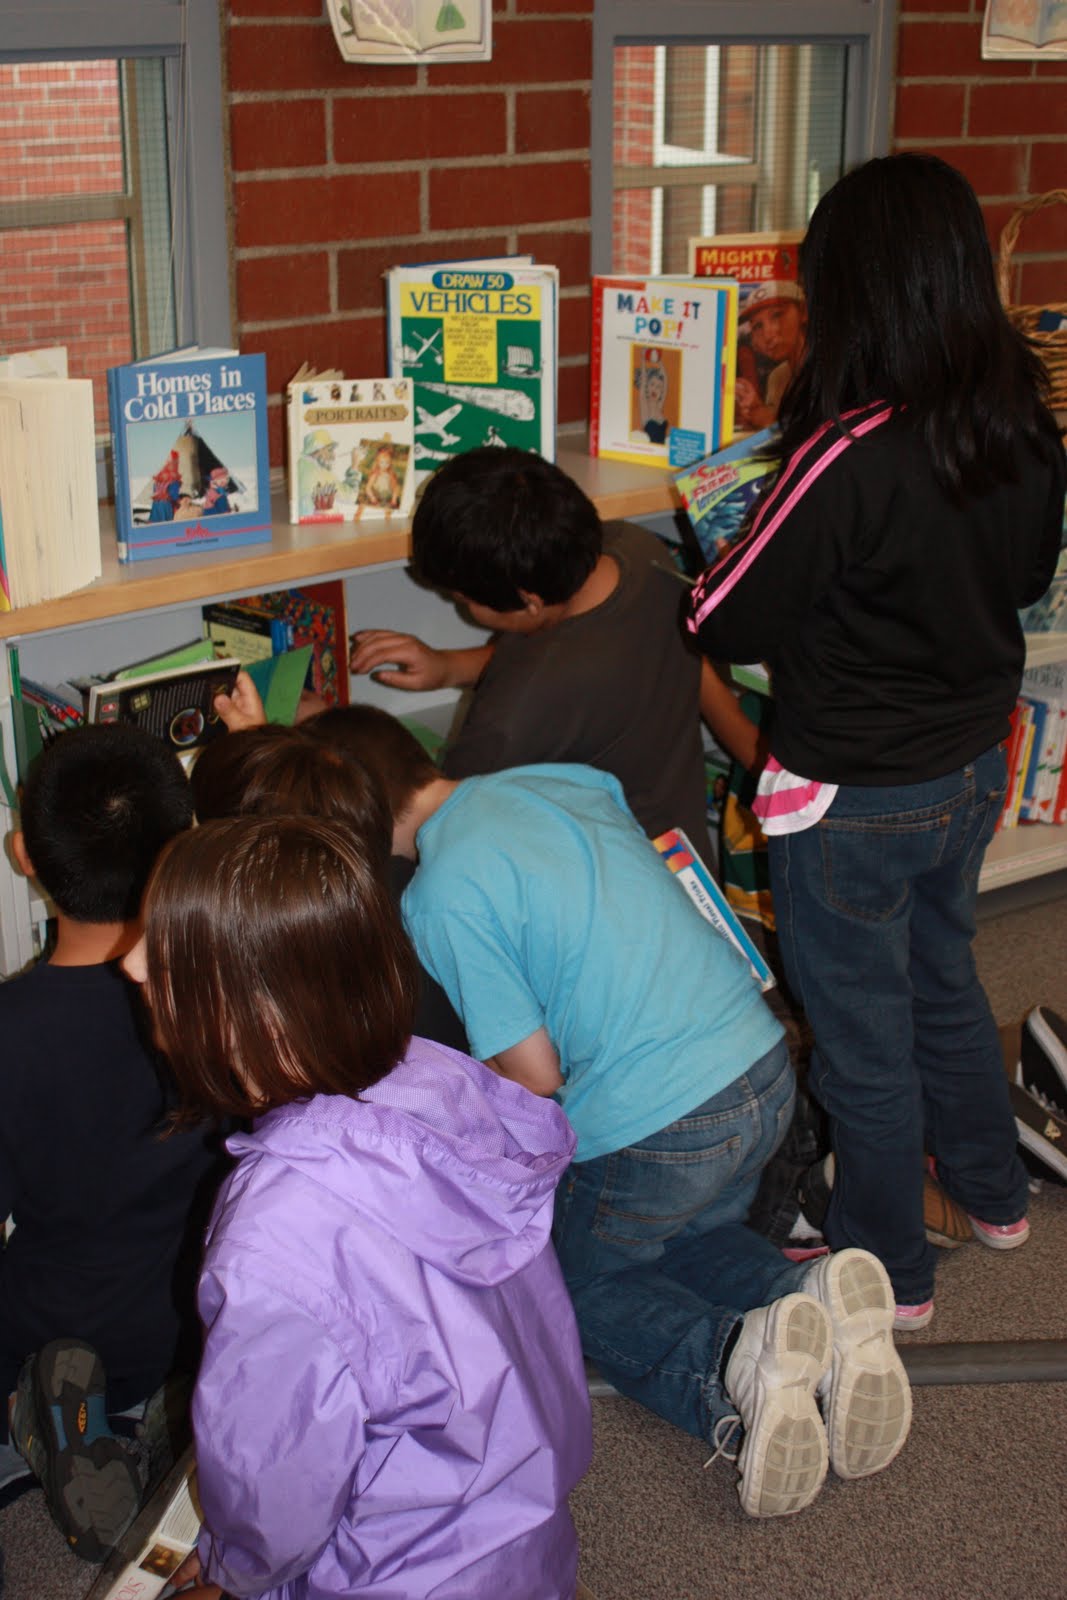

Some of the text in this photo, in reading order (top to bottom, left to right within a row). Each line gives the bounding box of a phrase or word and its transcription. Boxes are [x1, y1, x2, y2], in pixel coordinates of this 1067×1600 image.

[701, 248, 778, 266] MIGHTY
[441, 273, 485, 288] DRAW
[487, 274, 505, 289] 50
[705, 264, 774, 279] JACKIE
[410, 291, 532, 315] VEHICLES
[617, 293, 701, 320] MAKE IT
[635, 317, 684, 339] POP!
[136, 365, 242, 398] Homes in
[124, 391, 256, 423] Cold Places
[315, 407, 398, 423] PORTRAITS
[113, 1577, 146, 1600] STO
